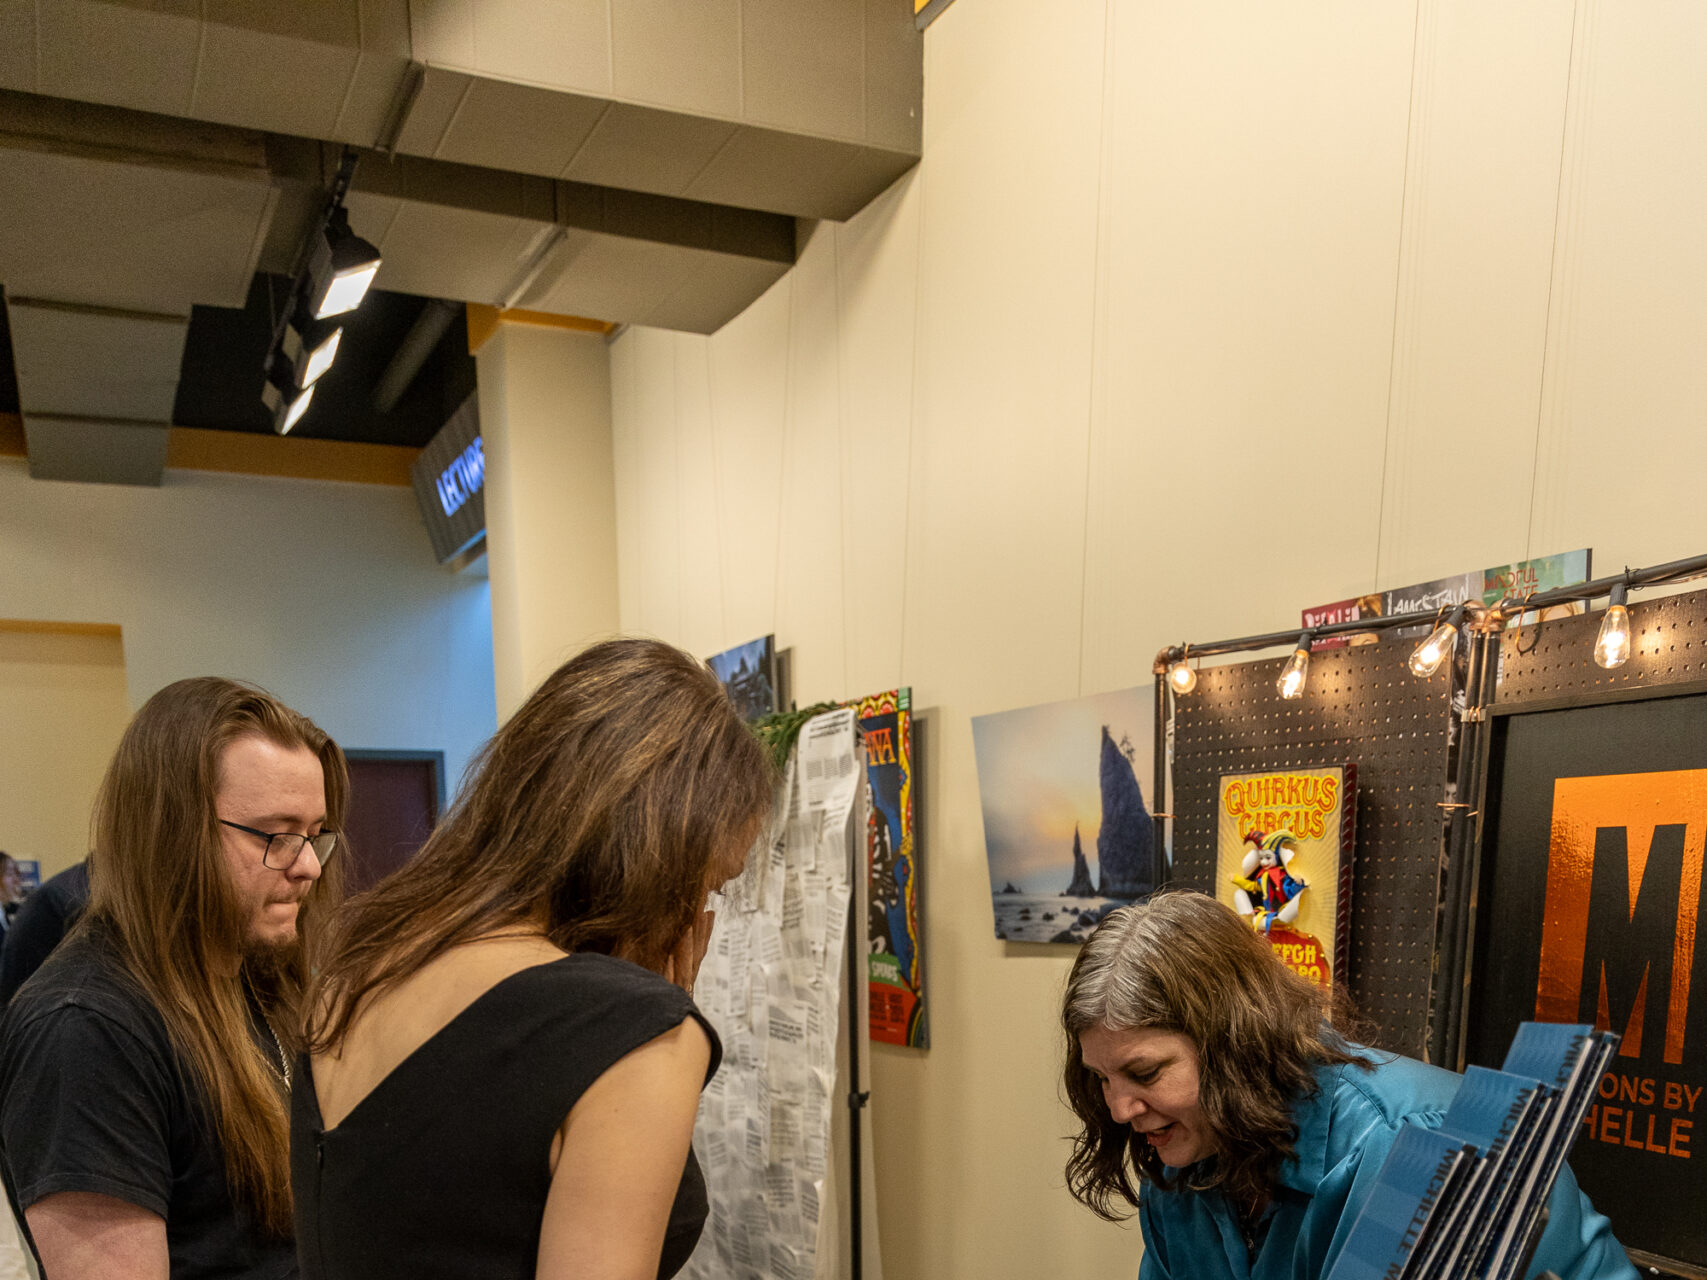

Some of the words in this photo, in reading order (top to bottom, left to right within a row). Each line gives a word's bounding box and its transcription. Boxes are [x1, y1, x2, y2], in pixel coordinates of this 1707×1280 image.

[1225, 776, 1337, 816] QUIRKUS
[1239, 809, 1325, 839] CIRCUS
[1663, 1081, 1703, 1113] BY
